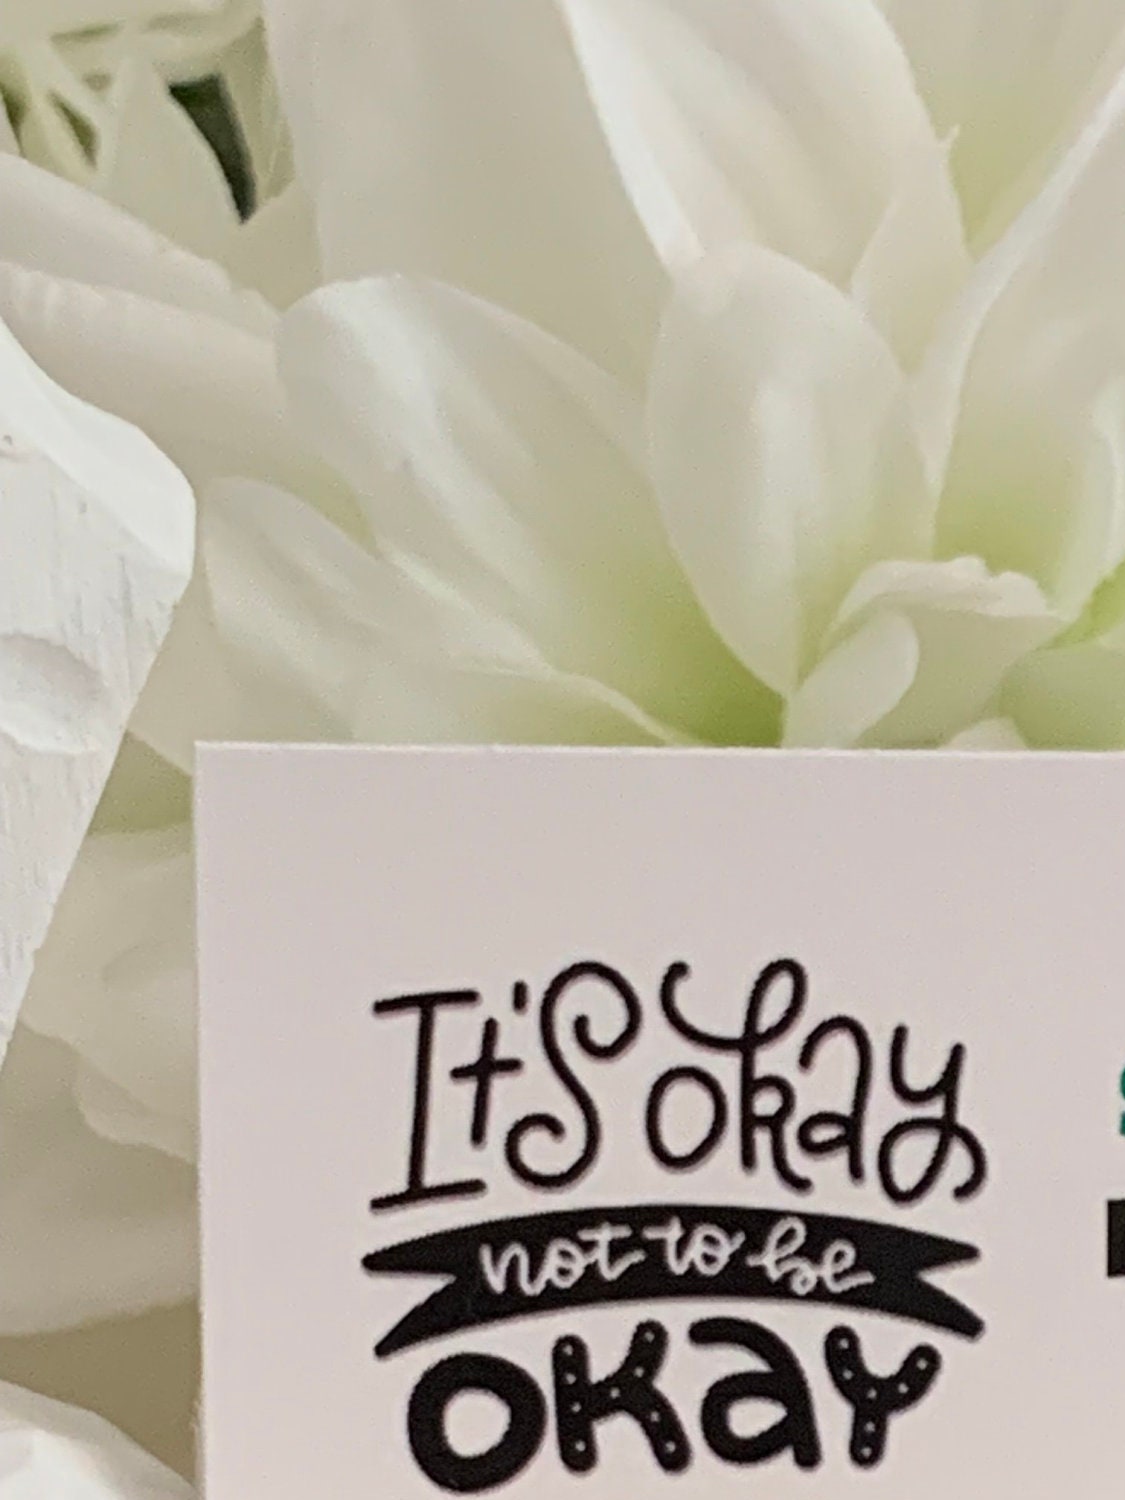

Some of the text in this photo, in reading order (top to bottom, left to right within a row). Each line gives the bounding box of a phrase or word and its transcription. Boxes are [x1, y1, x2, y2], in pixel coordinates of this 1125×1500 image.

[643, 957, 988, 1206] okay
[478, 1215, 876, 1297] not to be
